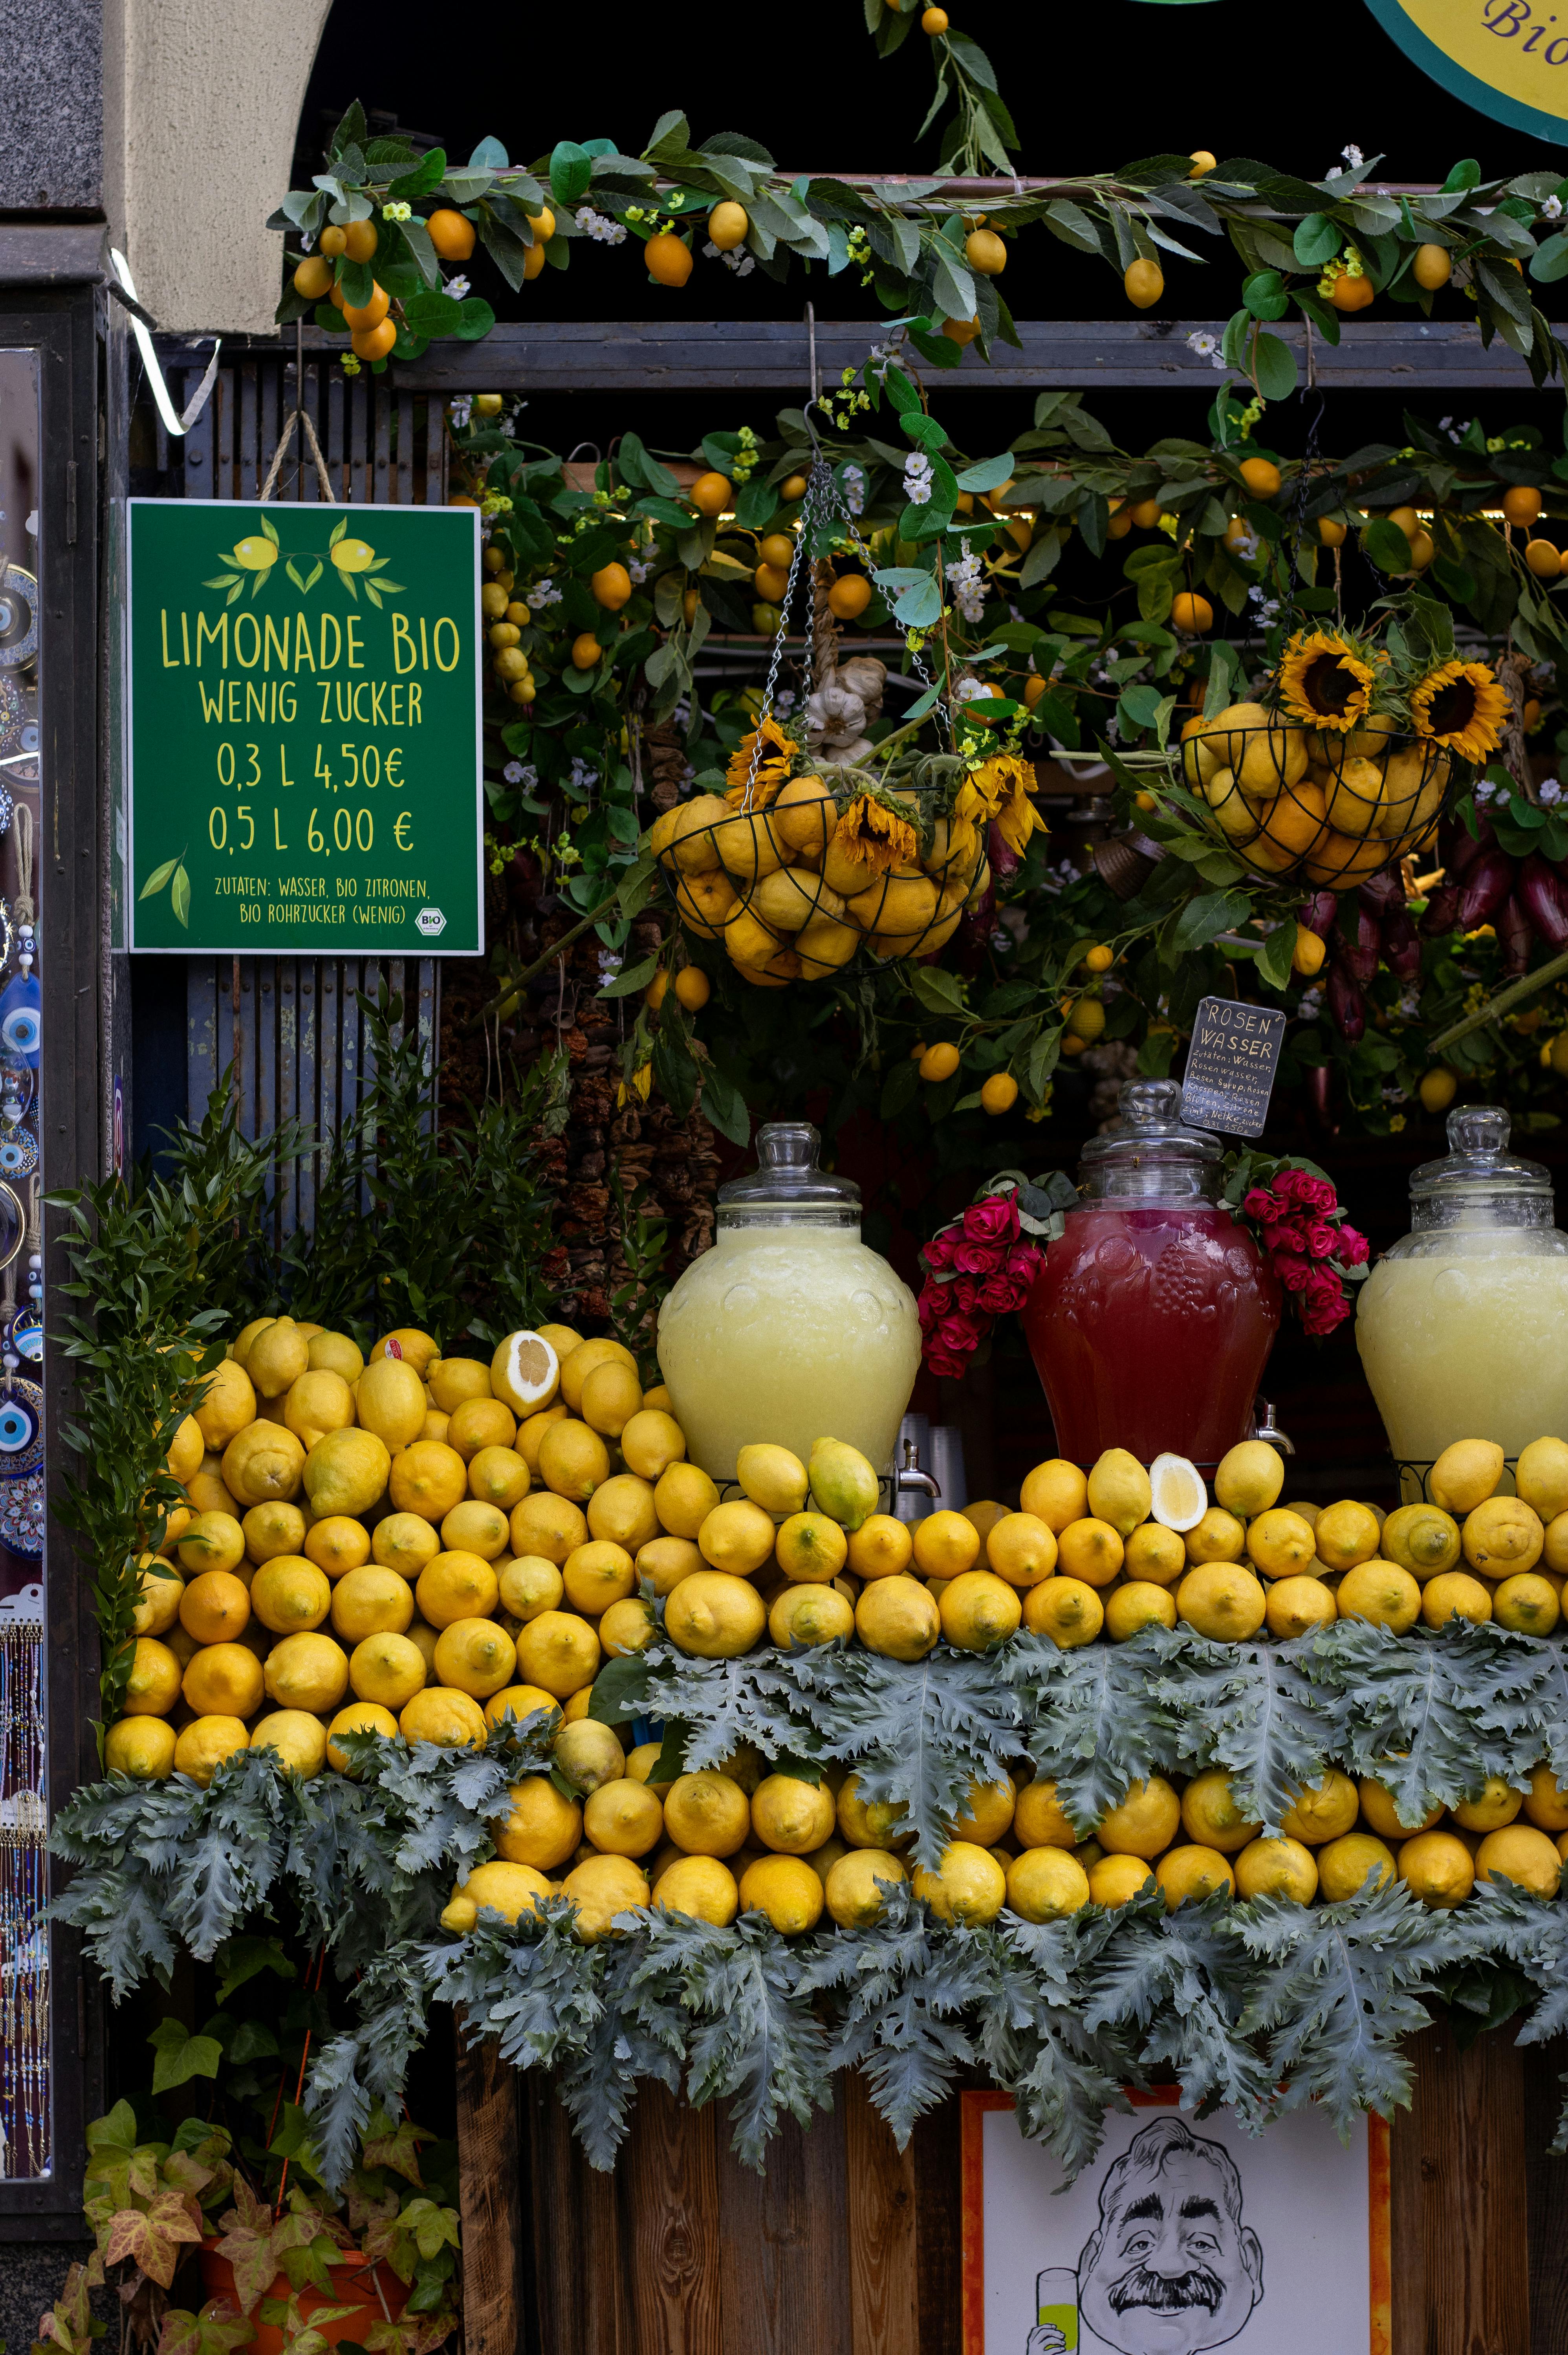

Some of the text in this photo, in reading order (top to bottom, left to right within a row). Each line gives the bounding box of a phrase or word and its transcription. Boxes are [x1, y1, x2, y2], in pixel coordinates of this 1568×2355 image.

[1481, 0, 1568, 65] Bio
[161, 608, 460, 674] LIMONADE BIO
[198, 679, 422, 727] WENIG ZUCKER
[217, 743, 405, 793] 0,3 L 4,50€
[209, 806, 414, 856] 0,5 L 6,00 €
[214, 876, 430, 900] ZUTATEN: WASSER, BIO ZITRONEN,
[240, 904, 405, 924] BIO ROHRZUCKER (WENIG)
[1208, 1004, 1271, 1035] ROSEN
[1201, 1028, 1273, 1058] WASSER
[1190, 1071, 1213, 1083] Rosen
[1247, 1085, 1269, 1096] Rosen
[1231, 1093, 1260, 1107] Rosen
